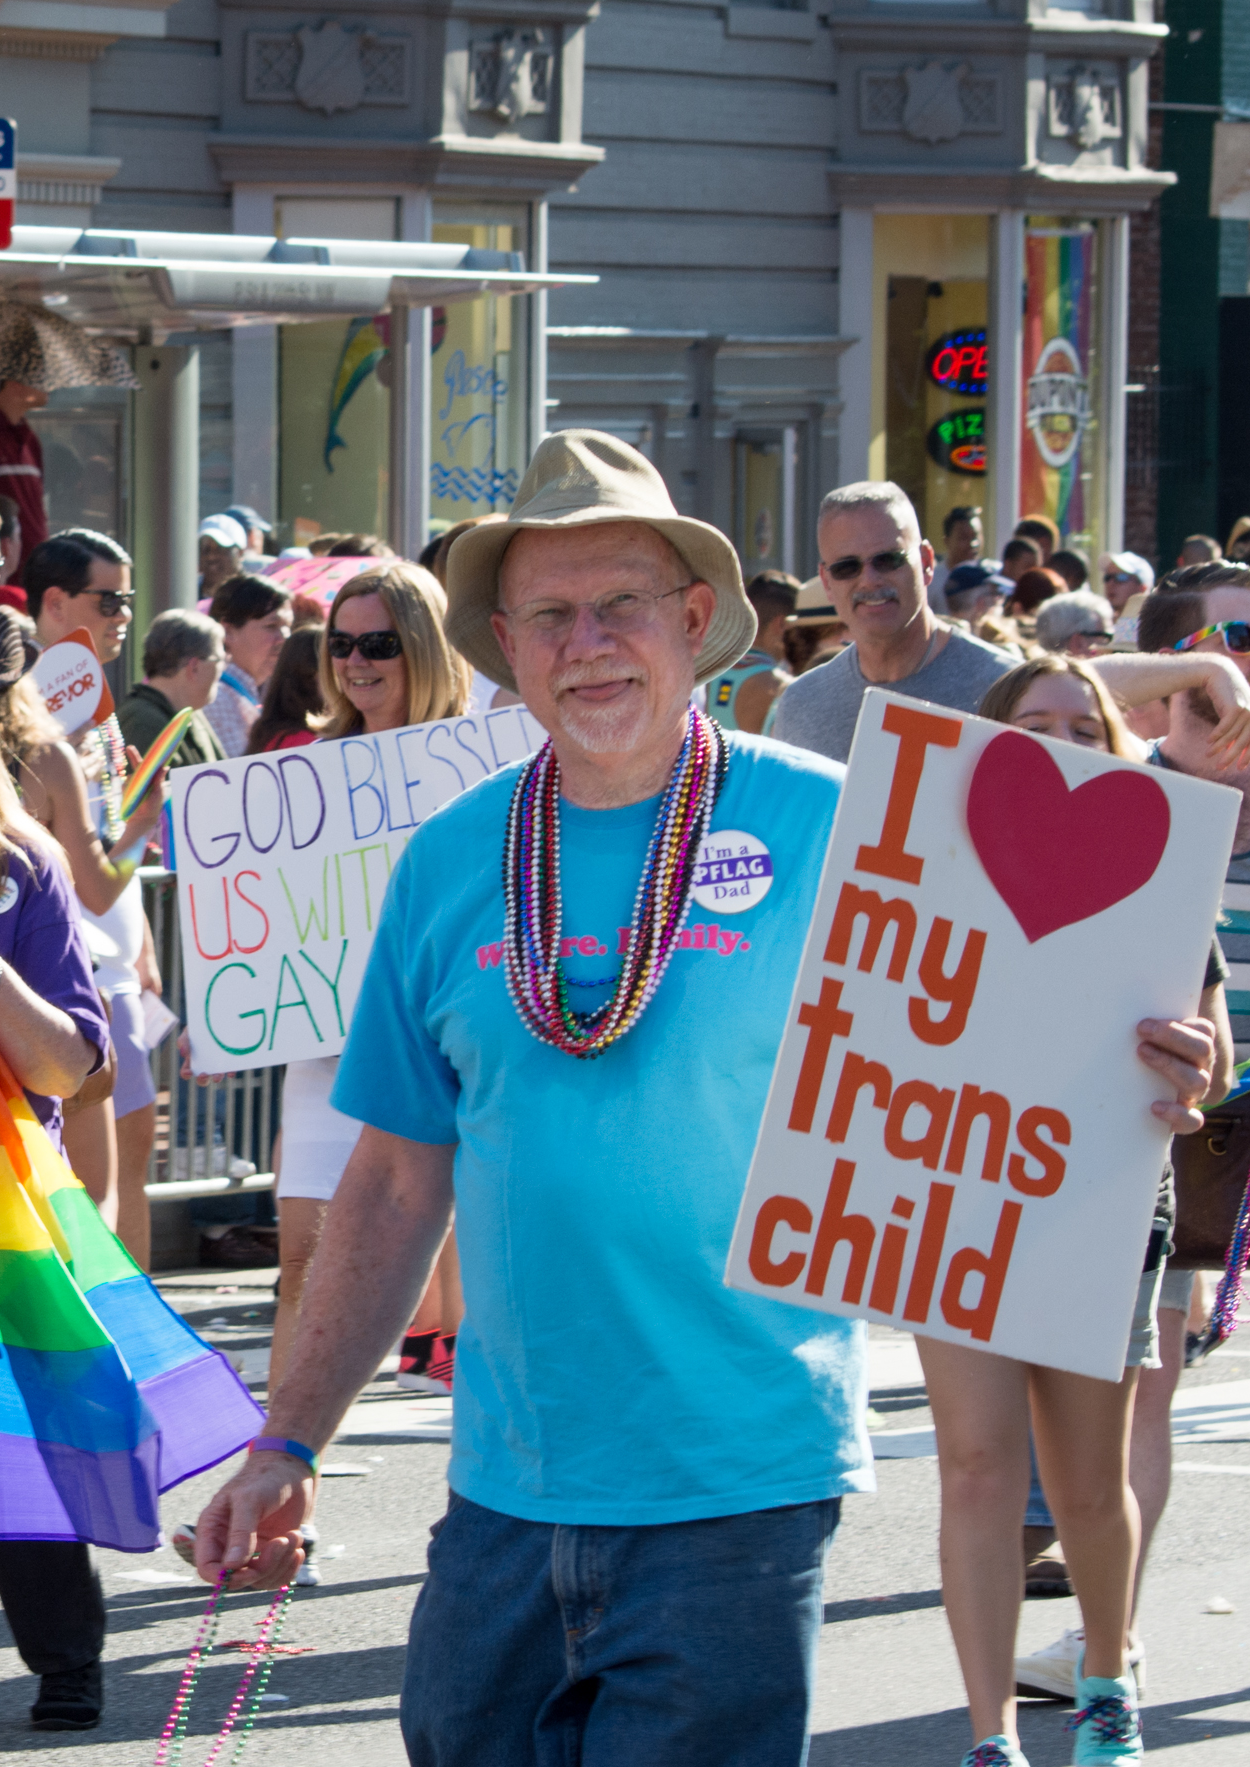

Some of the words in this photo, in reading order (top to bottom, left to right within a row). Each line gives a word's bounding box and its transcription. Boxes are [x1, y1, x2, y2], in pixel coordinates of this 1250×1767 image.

[55, 669, 74, 685] FAN
[75, 658, 88, 672] OF
[183, 754, 326, 869] GOD
[855, 703, 963, 885] I
[694, 857, 764, 883] PFLAG
[704, 846, 732, 860] I'm
[739, 845, 749, 855] a
[714, 880, 751, 900] Dad
[189, 869, 270, 961] US
[558, 935, 608, 958] re.
[616, 923, 751, 957] Fmily.
[823, 880, 987, 1046] my
[205, 938, 349, 1056] GAY
[787, 976, 1072, 1198] trans
[747, 1158, 1023, 1342] child
